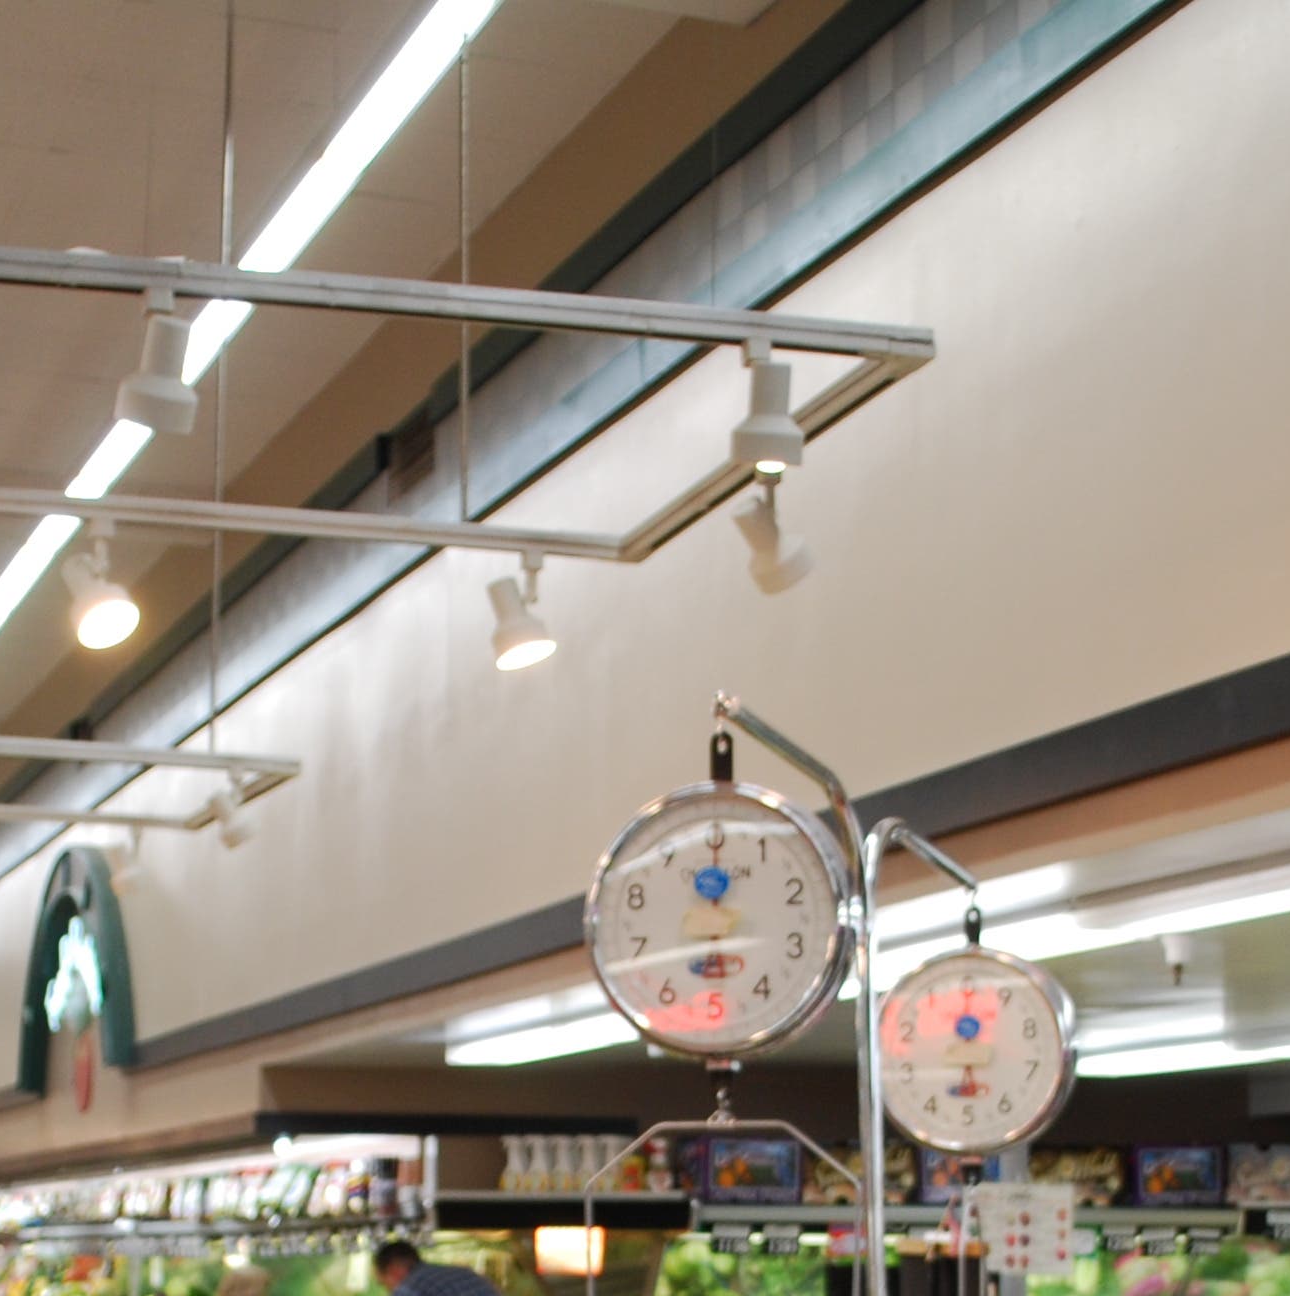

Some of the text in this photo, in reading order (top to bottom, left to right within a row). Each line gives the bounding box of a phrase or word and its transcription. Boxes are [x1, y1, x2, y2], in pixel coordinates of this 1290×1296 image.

[758, 838, 766, 862] 1
[628, 879, 803, 908] 8 2
[631, 932, 803, 958] 7 3
[659, 973, 771, 1018] 6 5 4
[999, 986, 1011, 1005] 9
[1023, 1018, 1037, 1038] 8
[1025, 1062, 1038, 1079] 7
[924, 1095, 1011, 1124] 4 5 6
